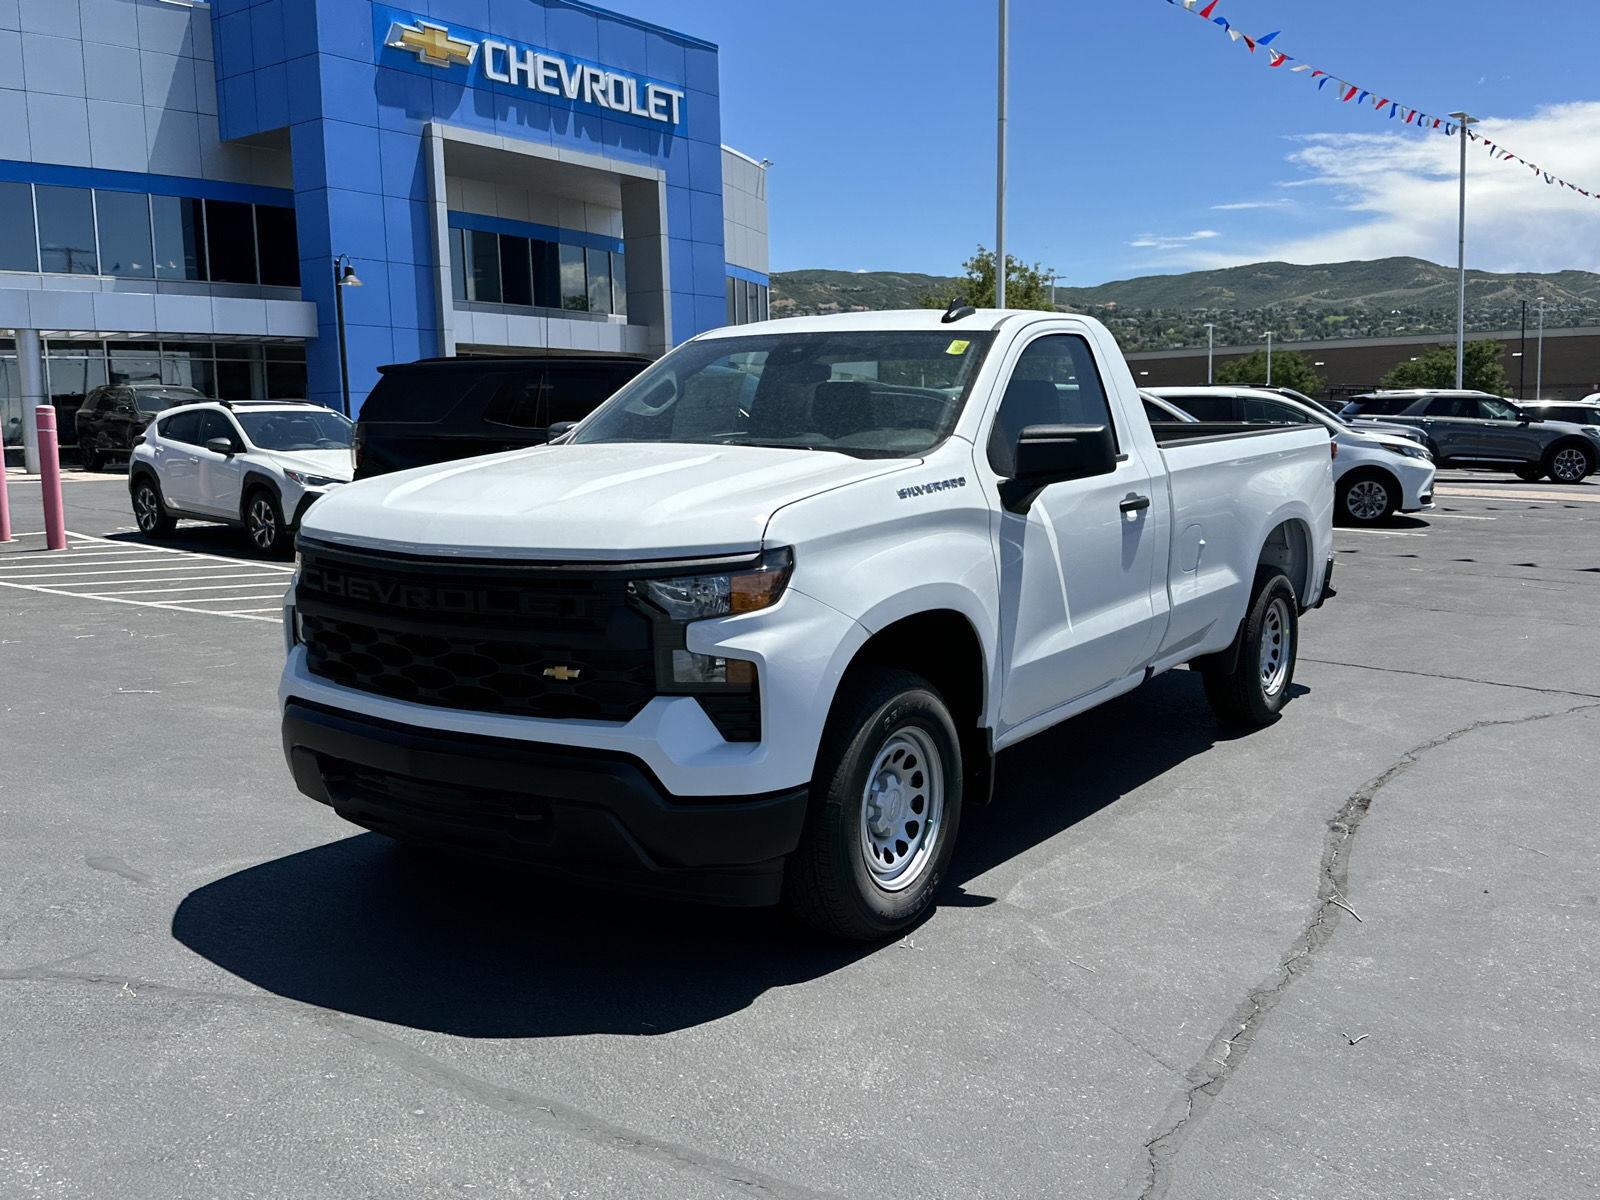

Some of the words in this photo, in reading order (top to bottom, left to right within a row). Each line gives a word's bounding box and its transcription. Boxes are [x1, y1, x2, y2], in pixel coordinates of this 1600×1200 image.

[482, 39, 684, 125] CHEVROLET
[896, 476, 967, 500] SILVERADO
[303, 567, 592, 618] CHEVROLET
